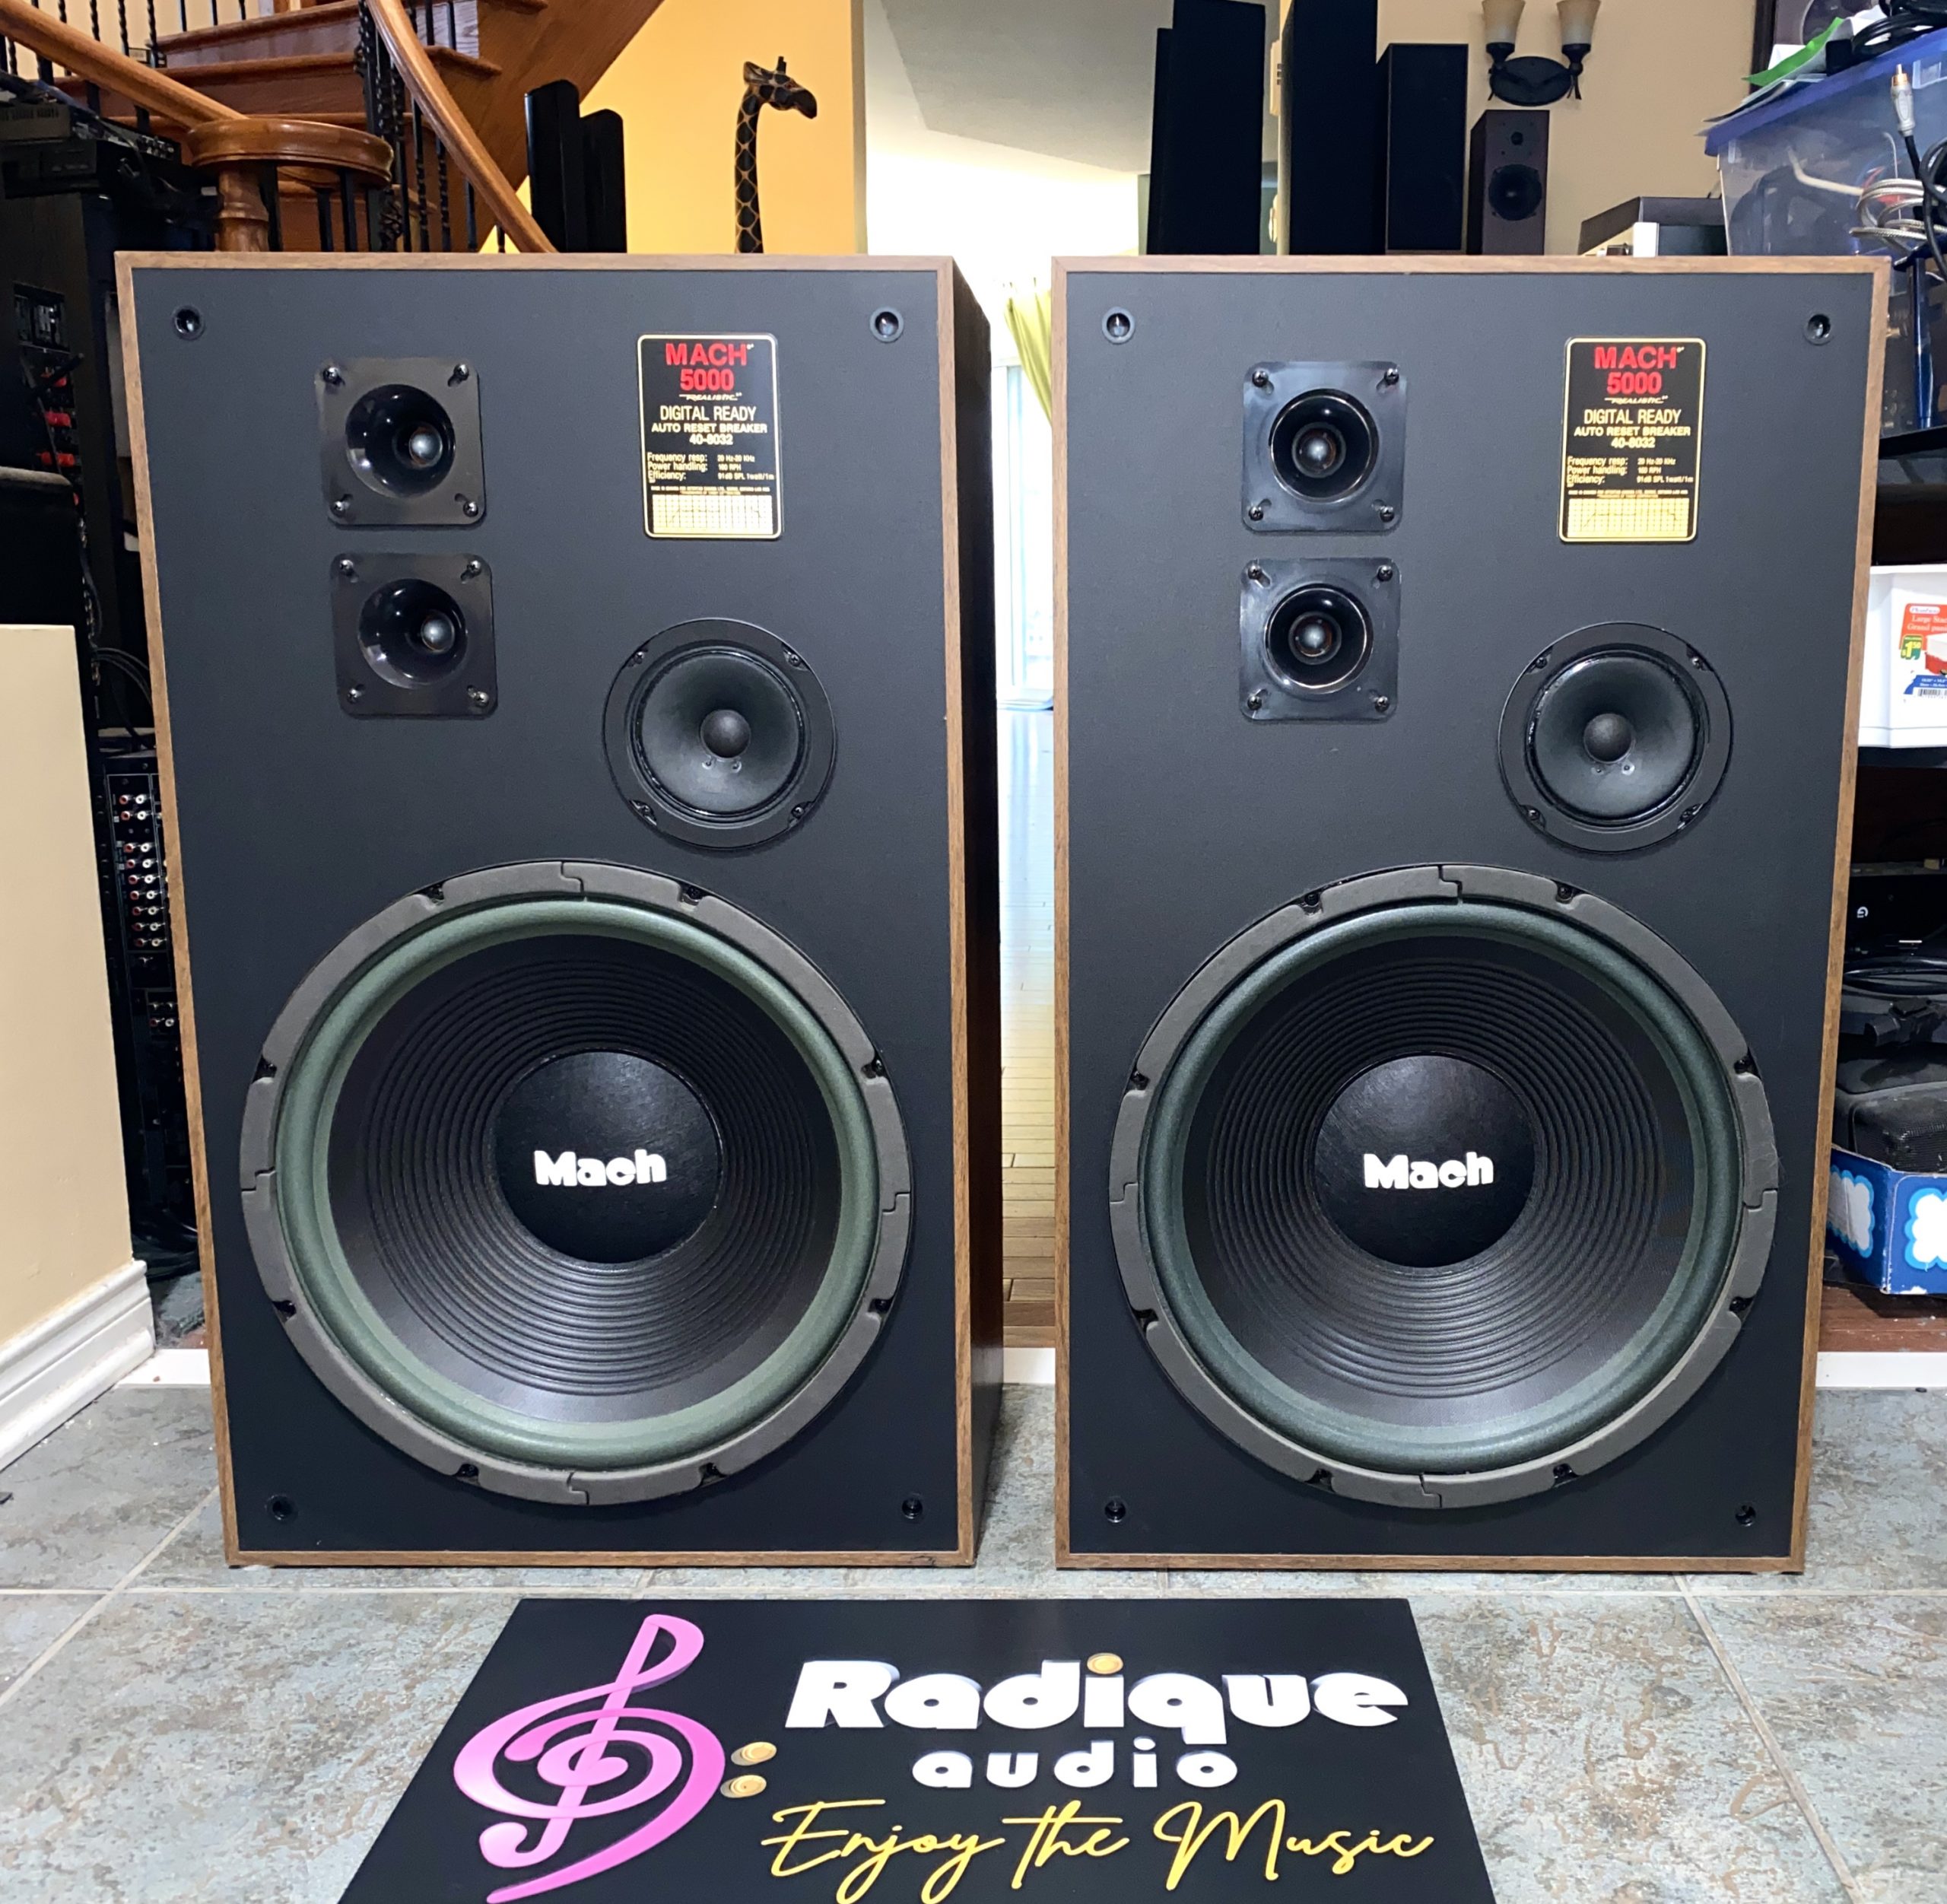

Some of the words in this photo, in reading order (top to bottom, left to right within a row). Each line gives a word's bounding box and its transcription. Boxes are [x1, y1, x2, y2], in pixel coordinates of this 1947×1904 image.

[665, 343, 748, 366] MACH
[1594, 346, 1677, 369] MACH
[680, 368, 735, 391] 5000
[1607, 372, 1662, 395] 5000
[660, 405, 710, 421] DIGITAL
[713, 405, 757, 421] READY
[1584, 409, 1634, 424] DIGITAL
[1637, 409, 1682, 424] READY
[651, 423, 681, 433] AUTO
[684, 423, 717, 433] RESET
[719, 423, 767, 434] BREAKER
[1574, 426, 1604, 437] AUTO
[1606, 426, 1640, 437] RESET
[1642, 426, 1691, 437] BREAKER
[647, 452, 686, 462] Frequency
[688, 453, 708, 462] resp:
[1567, 456, 1606, 467] Frequency
[1609, 458, 1628, 466] resp:
[648, 462, 671, 471] Power
[673, 462, 708, 472] handling:
[1567, 466, 1590, 475] Power
[1593, 466, 1628, 476] handling:
[648, 471, 686, 482] Efficiency:
[1567, 475, 1605, 485] Efficiency:
[534, 1149, 667, 1187] Mach
[1364, 1152, 1494, 1189] Mach
[785, 1652, 1409, 1745] Radique
[912, 1737, 1237, 1788] audio
[761, 1798, 1005, 1904] Enjoy
[1153, 1798, 1434, 1891] Music
